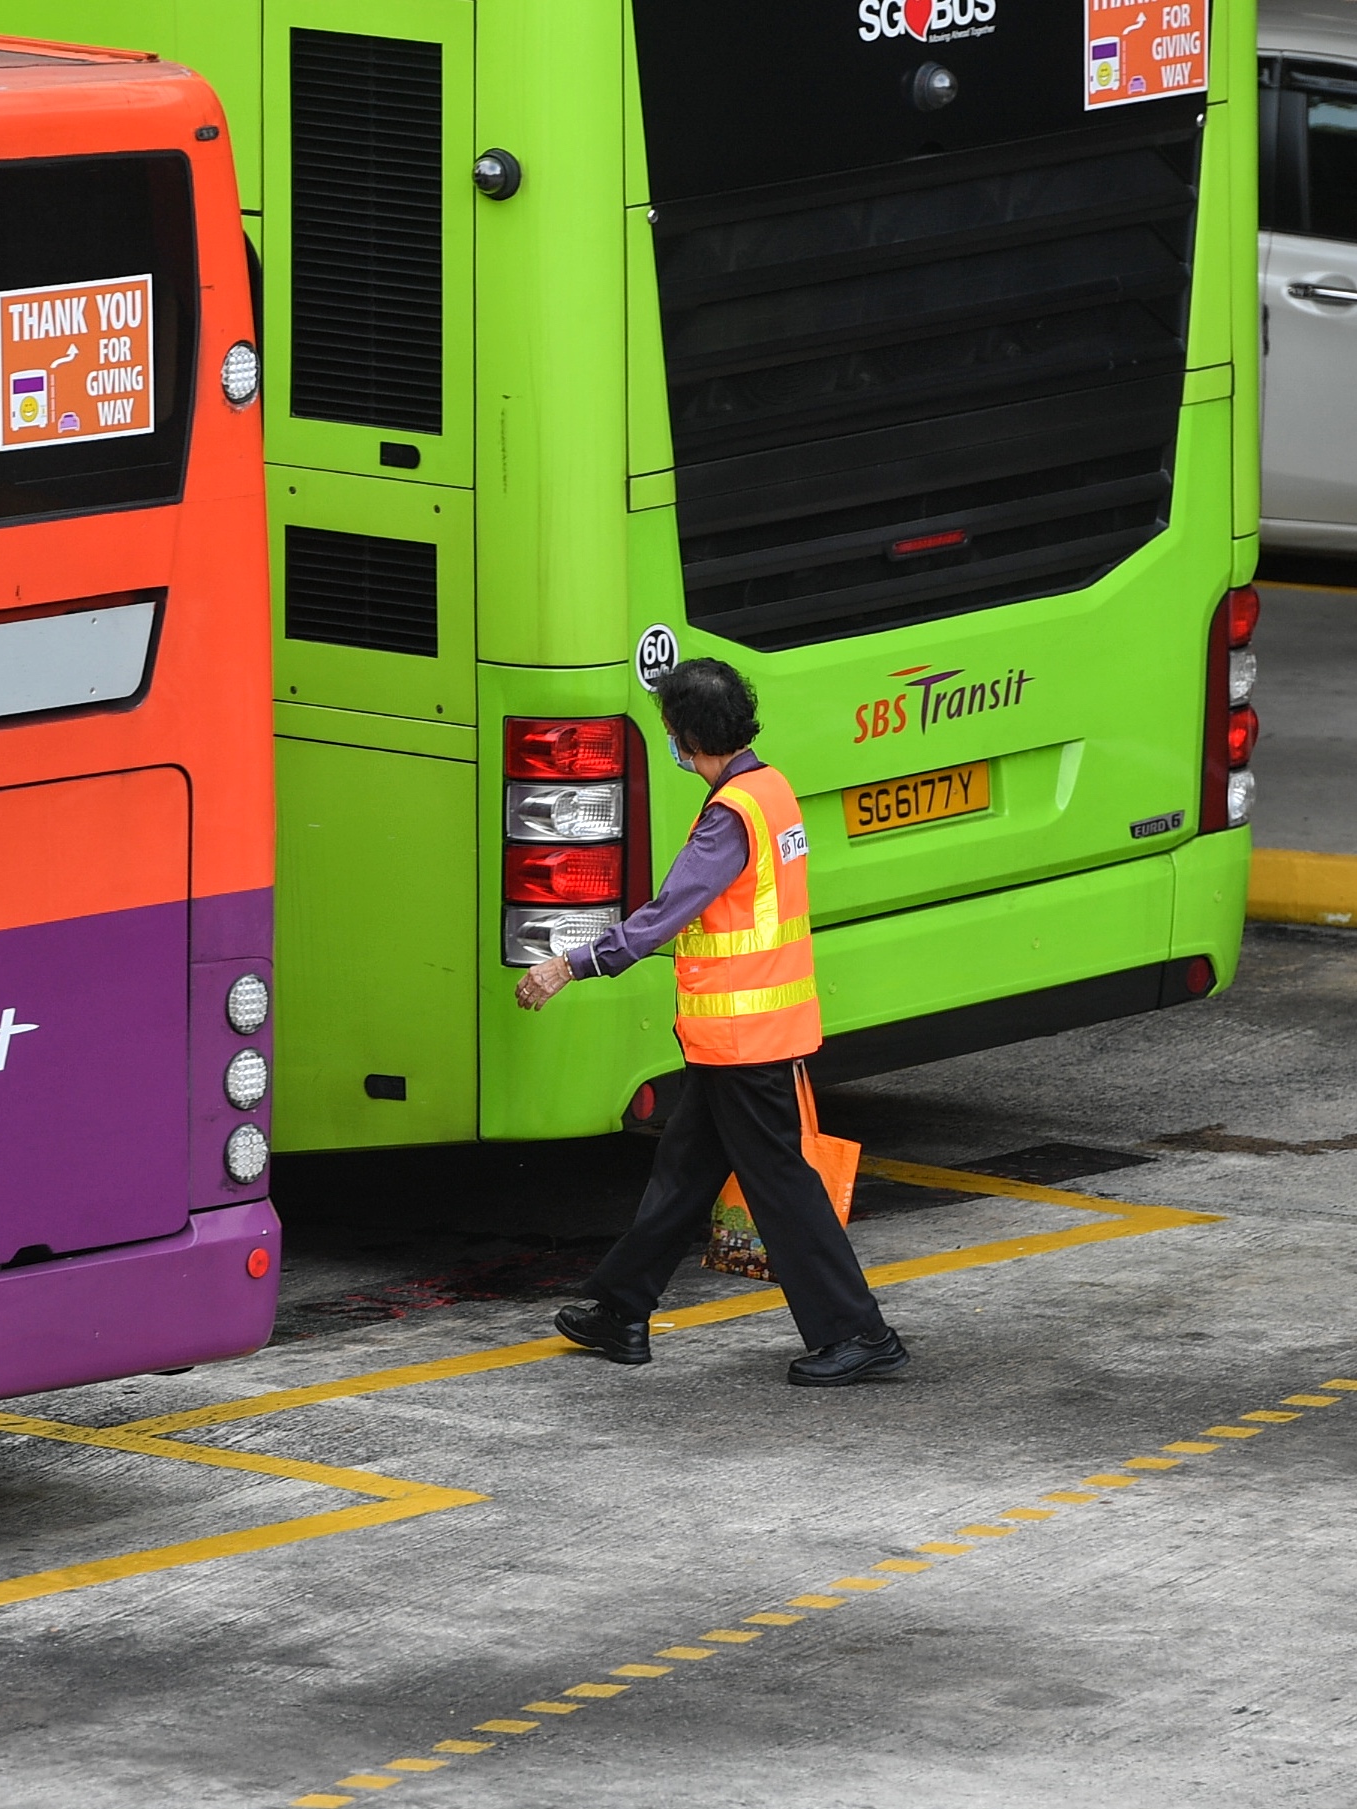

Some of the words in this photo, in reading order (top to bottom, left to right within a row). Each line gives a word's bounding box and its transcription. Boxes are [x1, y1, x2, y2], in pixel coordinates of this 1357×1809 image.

[858, 0, 906, 42] SG
[1162, 4, 1191, 30] FOR
[1152, 31, 1201, 60] GIVING
[1161, 62, 1192, 88] WAY
[8, 296, 88, 341] THANK
[95, 289, 142, 331] YOU
[99, 336, 131, 364] FOR
[86, 365, 143, 396] GIVING
[97, 398, 134, 426] WAY
[643, 633, 670, 665] 60
[853, 693, 907, 743] SBS
[904, 669, 1036, 735] Transit
[858, 770, 972, 826] SG6177Y
[1171, 812, 1181, 828] 6
